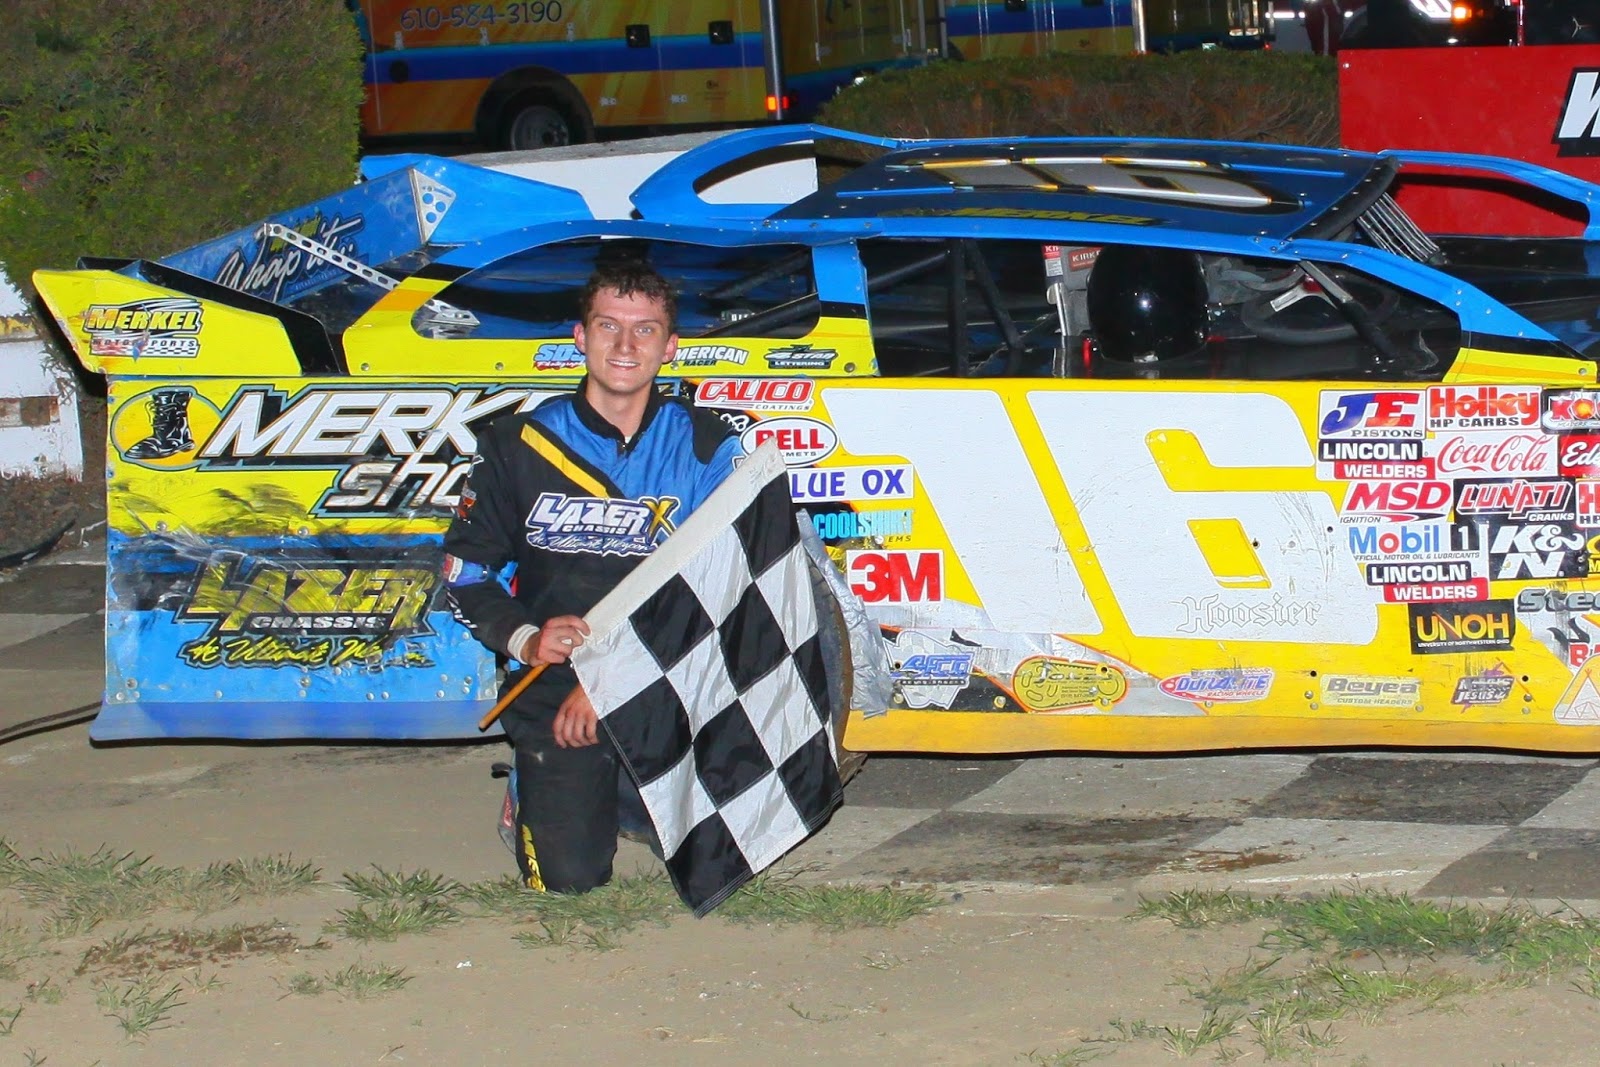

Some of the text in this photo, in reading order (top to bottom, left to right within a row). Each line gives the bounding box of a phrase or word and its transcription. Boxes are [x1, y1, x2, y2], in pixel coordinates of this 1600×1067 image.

[401, 2, 562, 30] 610-584-3190
[87, 308, 197, 330] MERKEL
[673, 346, 748, 365] MERICAN
[699, 380, 812, 401] CALICO
[755, 403, 810, 411] COATINGS
[1321, 392, 1421, 436] JE
[1430, 387, 1540, 427] Holley
[203, 390, 560, 457] MERK
[1350, 429, 1424, 438] PISTONS
[1430, 417, 1520, 428] HP CARBS
[1323, 442, 1418, 460] LINCOLN
[1437, 435, 1553, 473] Coca-Cola
[1344, 463, 1427, 478] WELDERS
[792, 469, 905, 498] LUE OX
[1346, 481, 1450, 510] MSD
[1459, 481, 1567, 513] LUNATI
[532, 498, 650, 535] LAZER
[562, 524, 627, 534] CHASSIS
[1529, 513, 1575, 521] CRANKS
[1349, 525, 1469, 554] Mobil 1
[851, 553, 941, 603] 3M
[1371, 563, 1467, 583] LINCOLN
[187, 560, 434, 630] LAZER
[1393, 585, 1478, 600] WELDERS
[251, 616, 386, 629] CHASSIS
[1176, 594, 1322, 633] Hoosier
[1416, 612, 1510, 641] UNOH
[1328, 678, 1418, 696] Beyea
